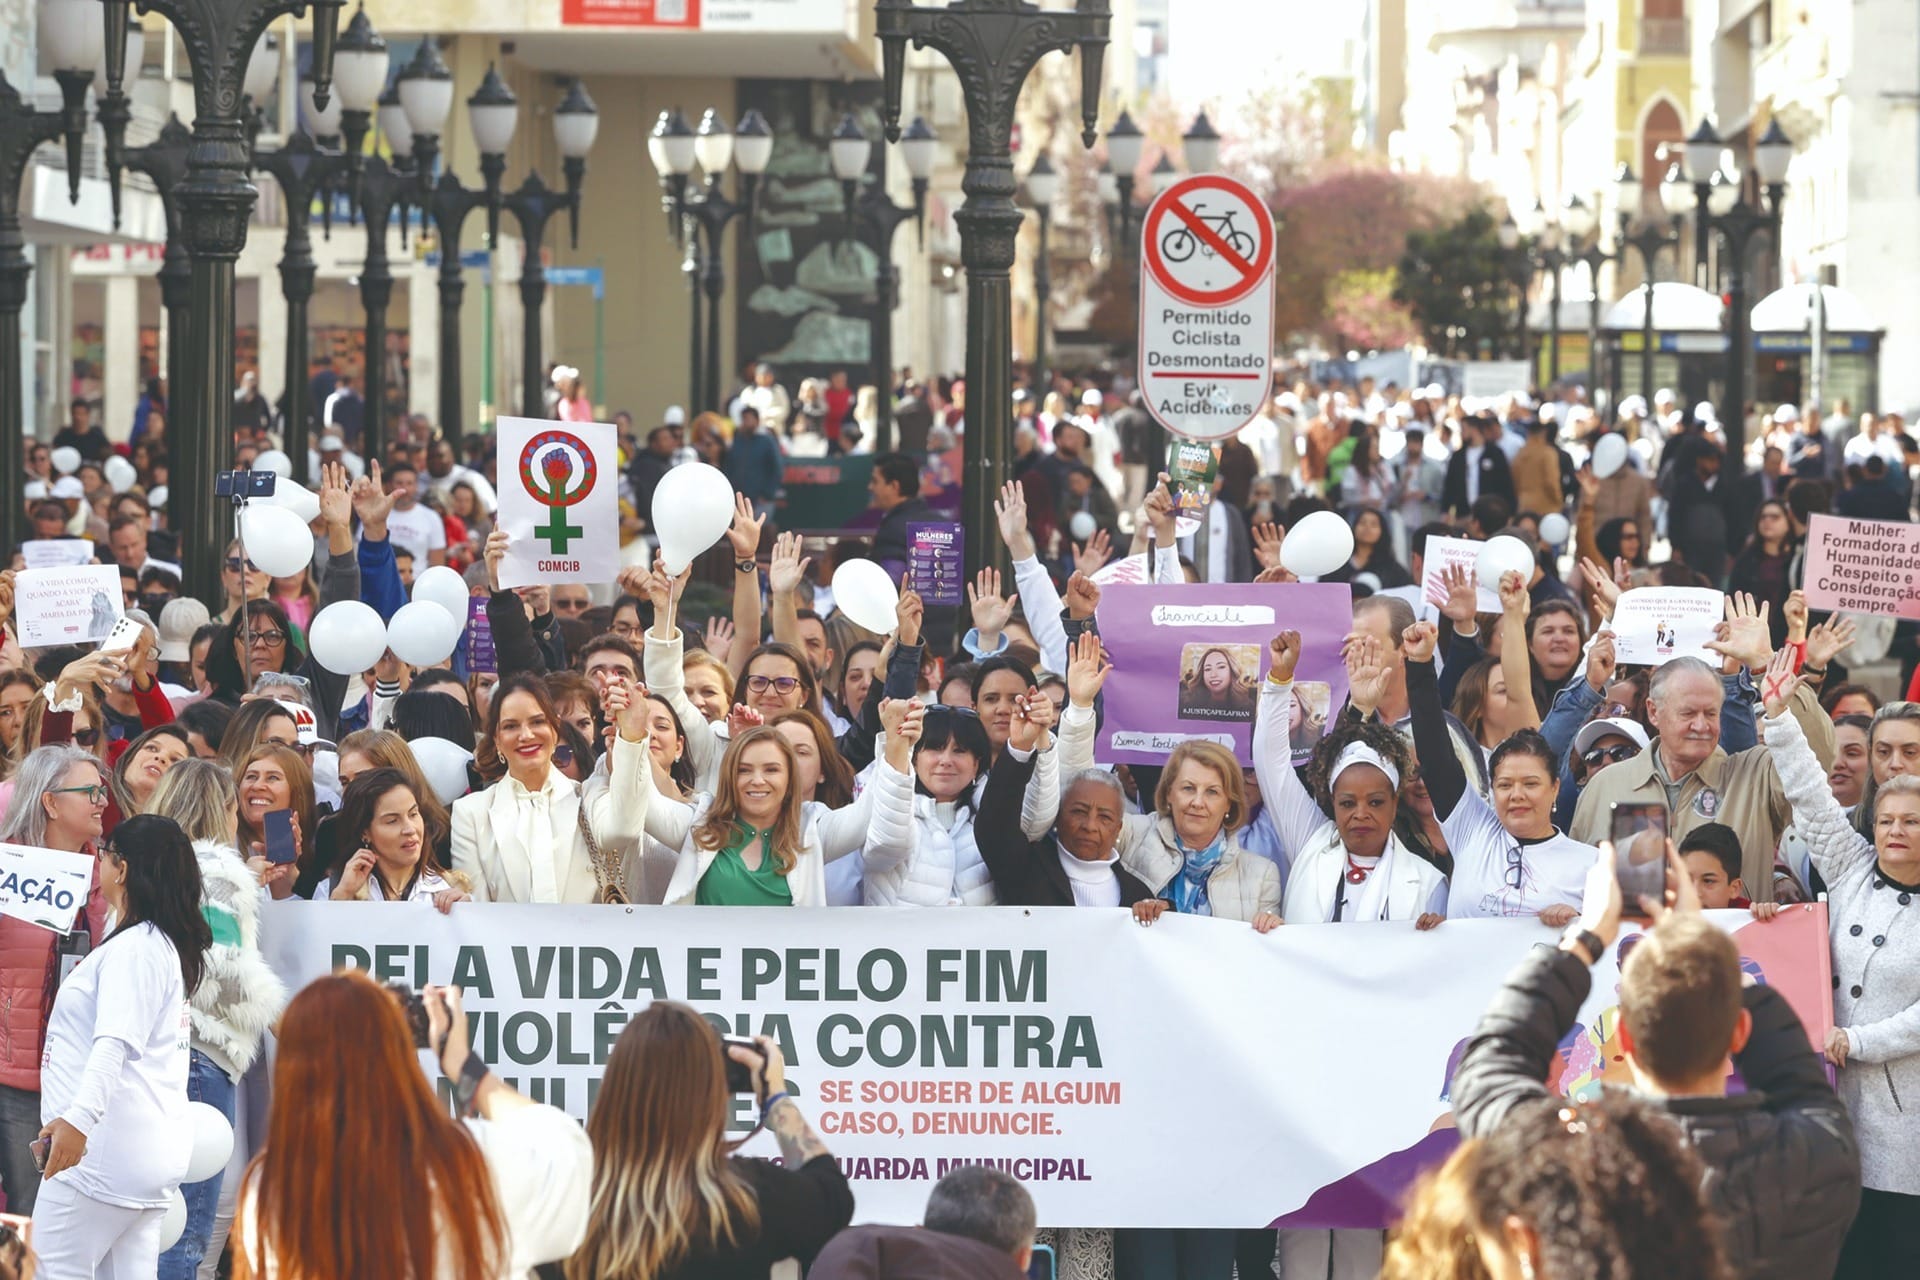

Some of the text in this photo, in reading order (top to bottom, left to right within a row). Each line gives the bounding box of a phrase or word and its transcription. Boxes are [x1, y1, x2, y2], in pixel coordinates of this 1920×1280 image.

[1162, 309, 1252, 325] Permitido
[1172, 330, 1241, 345] Ciclista
[1148, 352, 1265, 368] Desmontado
[1184, 382, 1221, 398] Evi
[915, 532, 954, 540] MULHERES
[1848, 521, 1907, 538] Mulher:
[1822, 533, 1920, 555] Formadora d
[538, 560, 580, 572] COMCIB
[1832, 564, 1913, 585] Respeito e
[46, 579, 65, 587] VIDA
[65, 577, 99, 586] COMEÇA
[26, 589, 61, 600] QUANDO
[1838, 597, 1901, 614] sempre.
[1182, 708, 1250, 718] #JUSTIÇAPELAFRAN
[0, 868, 74, 910] AÇÃO
[510, 946, 668, 1000] VIDA
[687, 948, 721, 1000] E
[742, 948, 907, 1002] PELO
[926, 949, 1048, 1002] FIM
[816, 1013, 1103, 1068] CONTRA
[820, 1080, 1121, 1105] SE SOUBER DE ALGUM
[819, 1111, 1063, 1139] CASO, DENUNCIE.
[837, 1157, 929, 1181] UARDA
